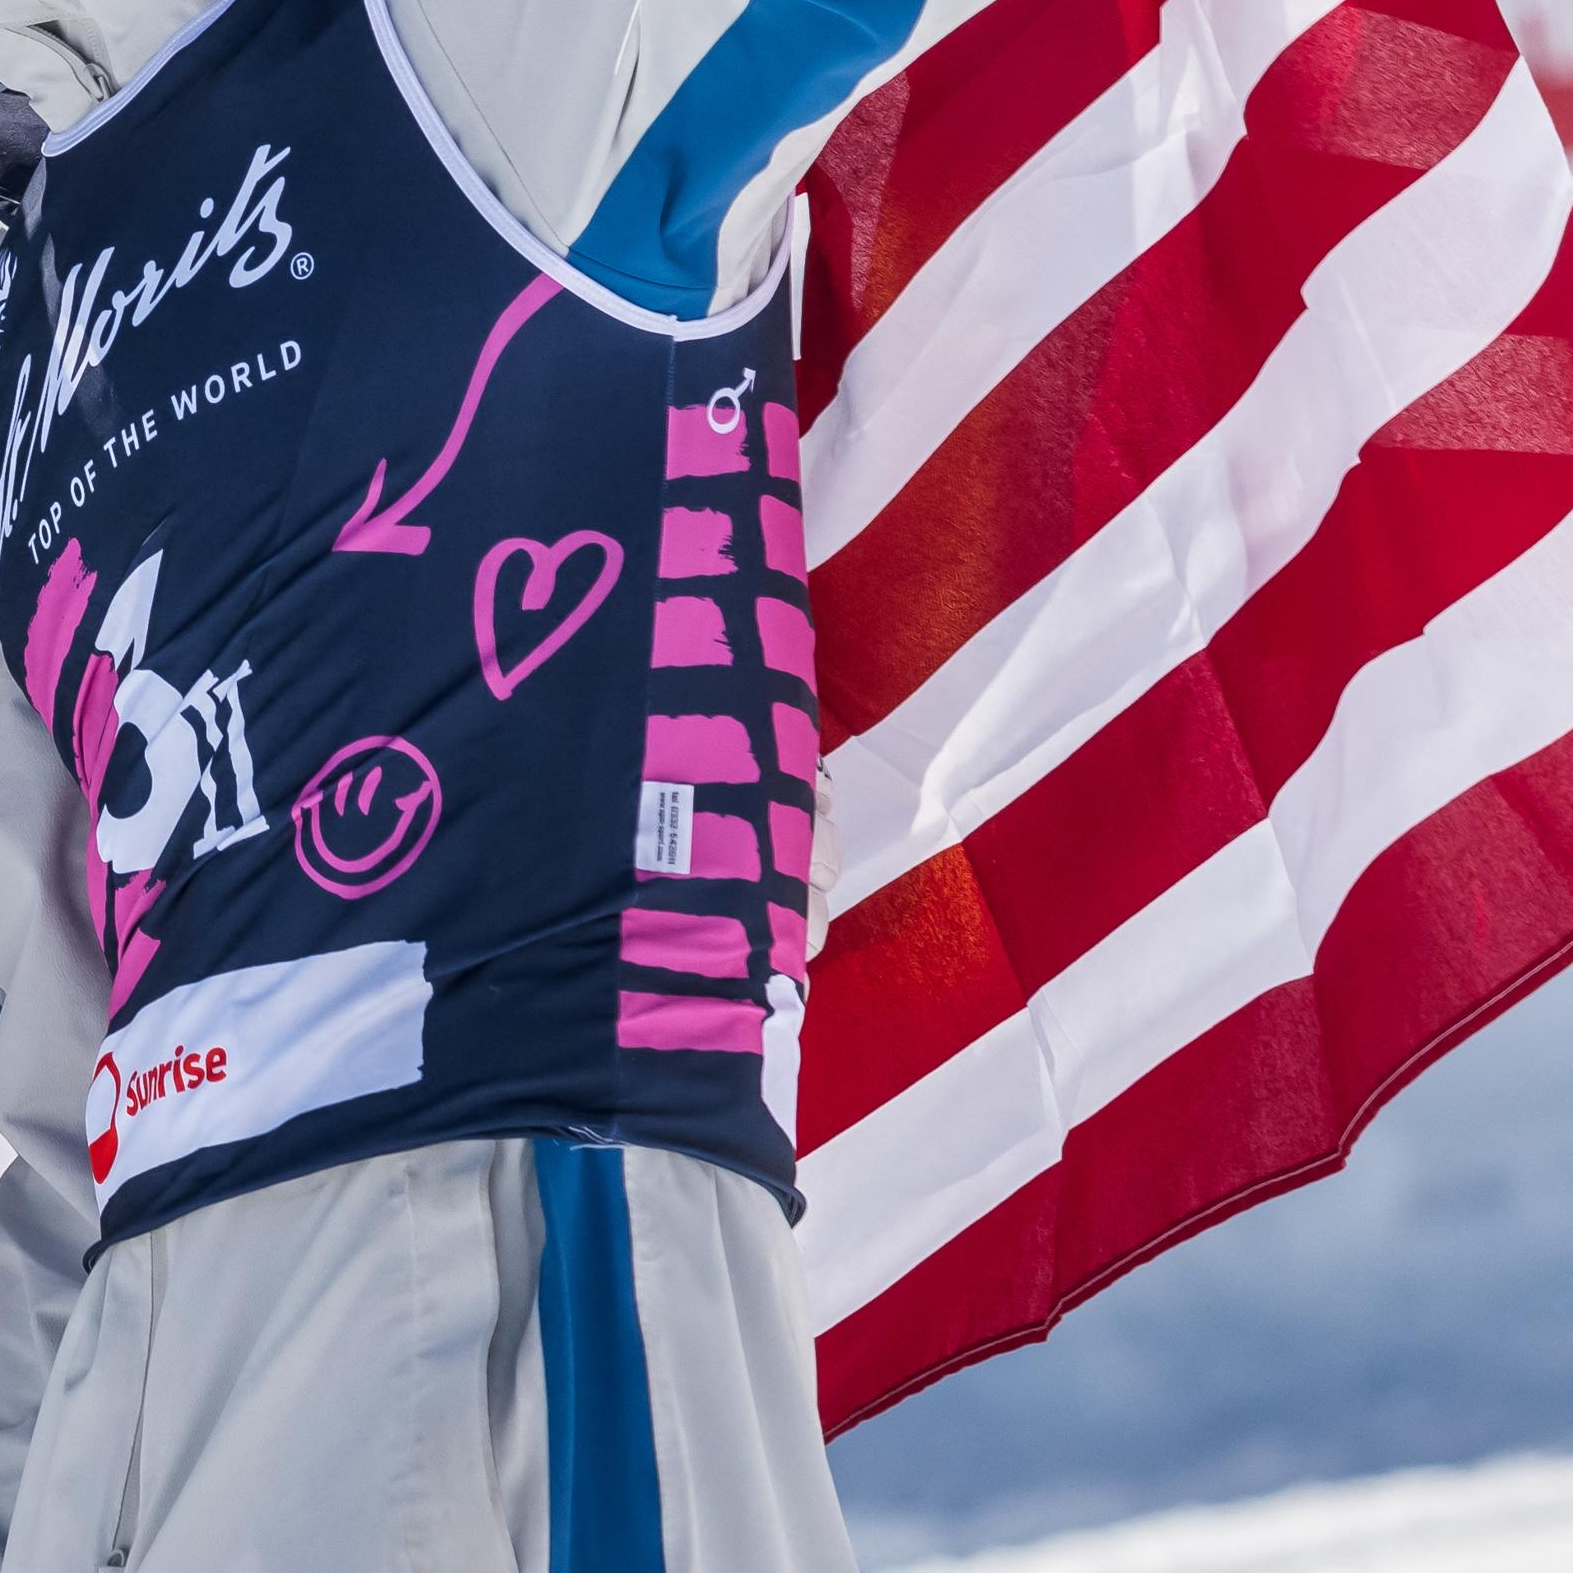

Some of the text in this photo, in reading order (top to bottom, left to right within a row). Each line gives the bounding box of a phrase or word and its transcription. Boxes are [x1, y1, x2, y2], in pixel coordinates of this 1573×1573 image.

[19, 144, 293, 502] Moritz
[28, 340, 301, 565] TOP OF THE WORLD
[126, 1045, 227, 1116] Sunrise
